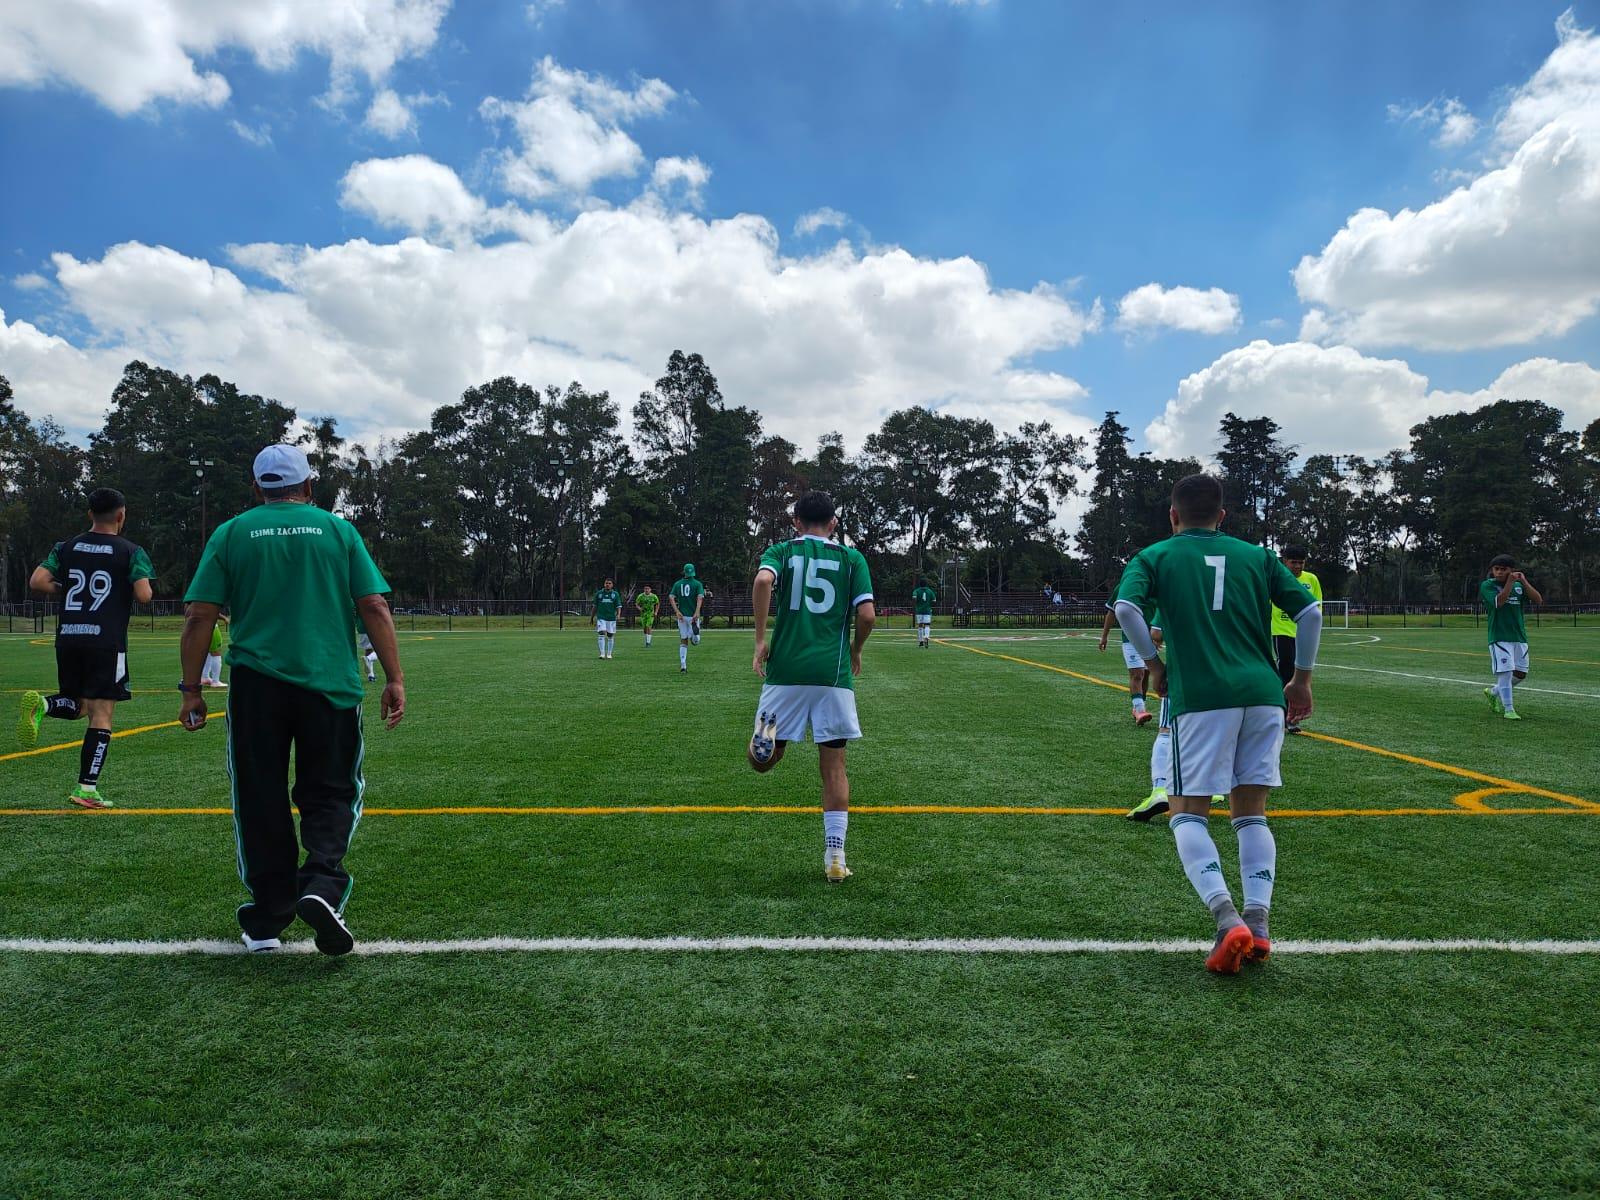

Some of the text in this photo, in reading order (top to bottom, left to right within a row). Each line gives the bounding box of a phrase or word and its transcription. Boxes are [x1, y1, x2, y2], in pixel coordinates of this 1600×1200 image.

[250, 526, 323, 539] ESIME ZACATENCO
[73, 542, 114, 555] ESIME
[65, 568, 112, 612] 29
[680, 583, 691, 597] 10
[788, 555, 840, 614] 15
